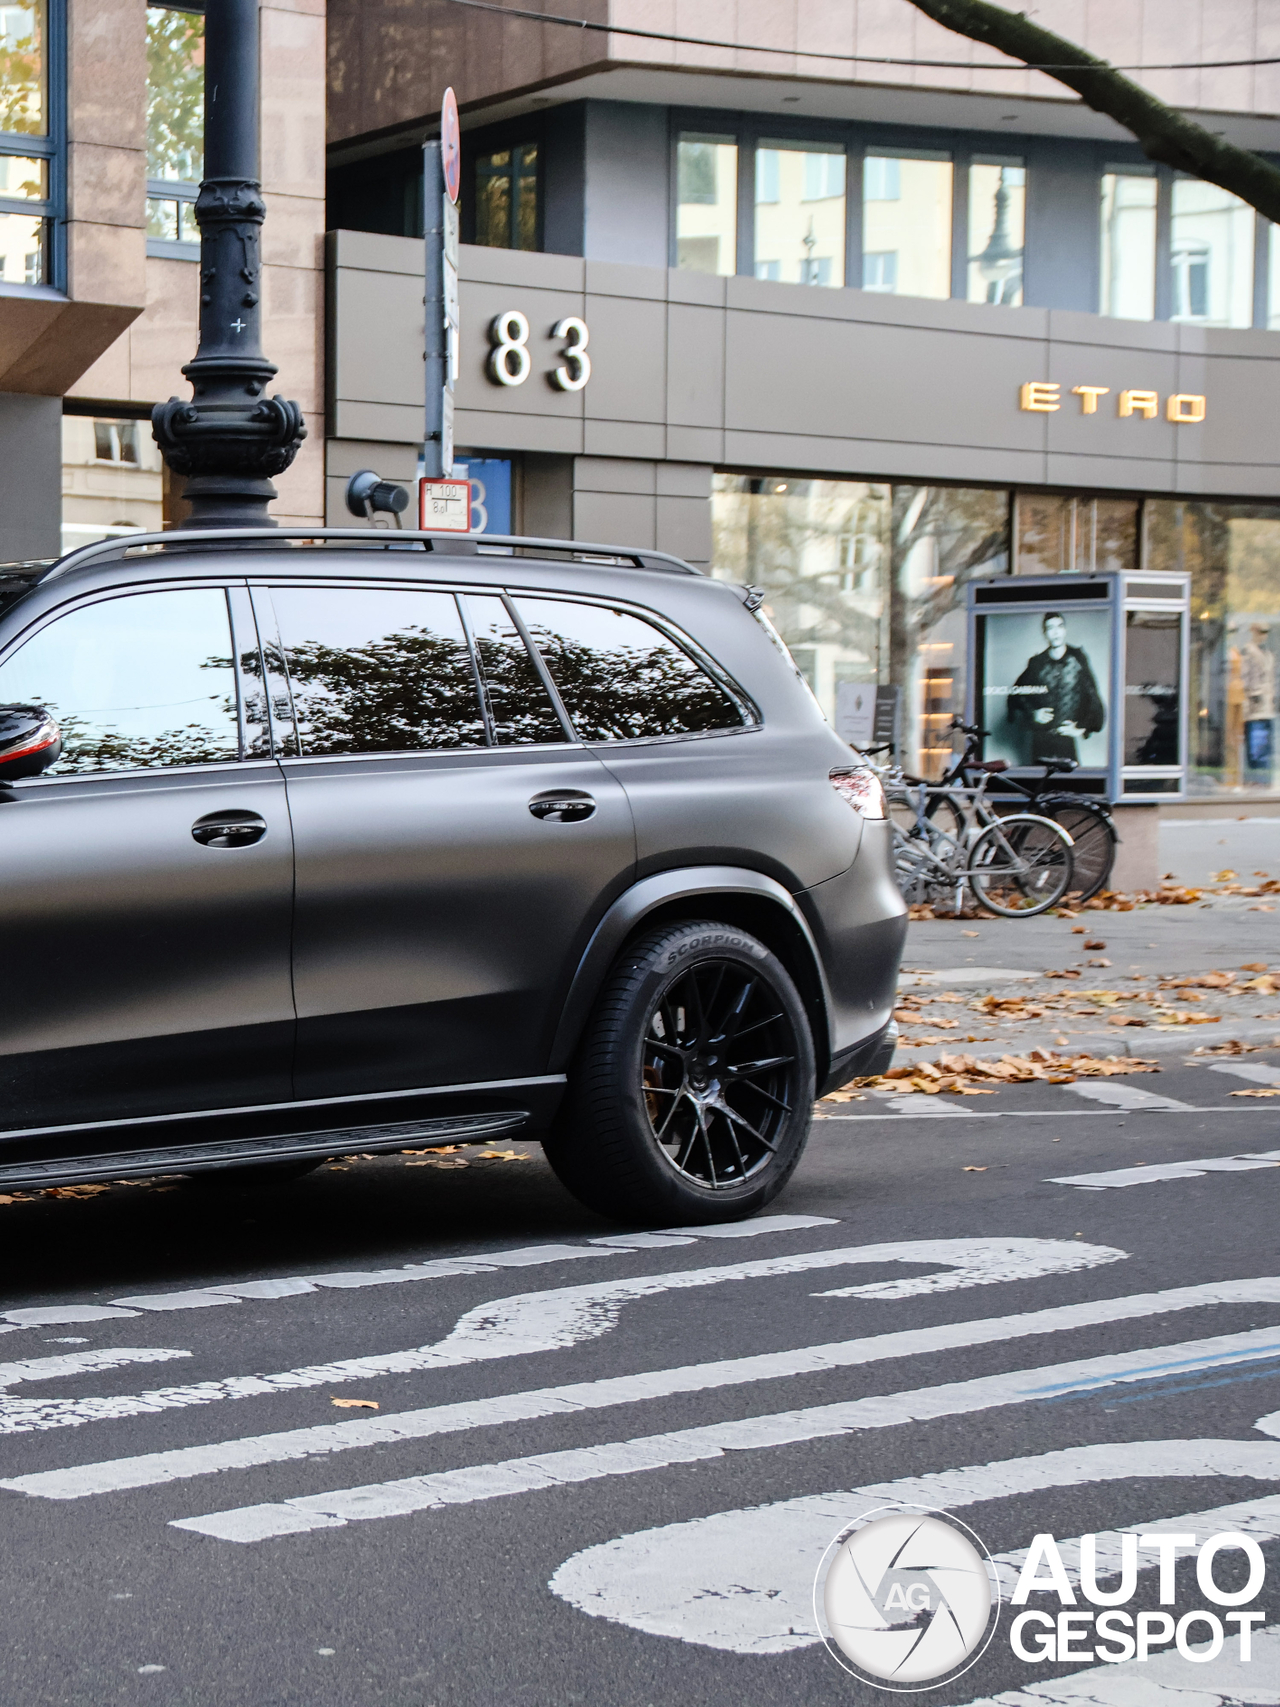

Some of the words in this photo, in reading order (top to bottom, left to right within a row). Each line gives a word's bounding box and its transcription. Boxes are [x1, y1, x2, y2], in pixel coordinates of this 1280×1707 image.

[489, 310, 591, 392] 83
[1020, 381, 1206, 423] ETRO
[426, 484, 433, 496] H
[439, 484, 457, 497] 100
[667, 934, 754, 965] SCORPION
